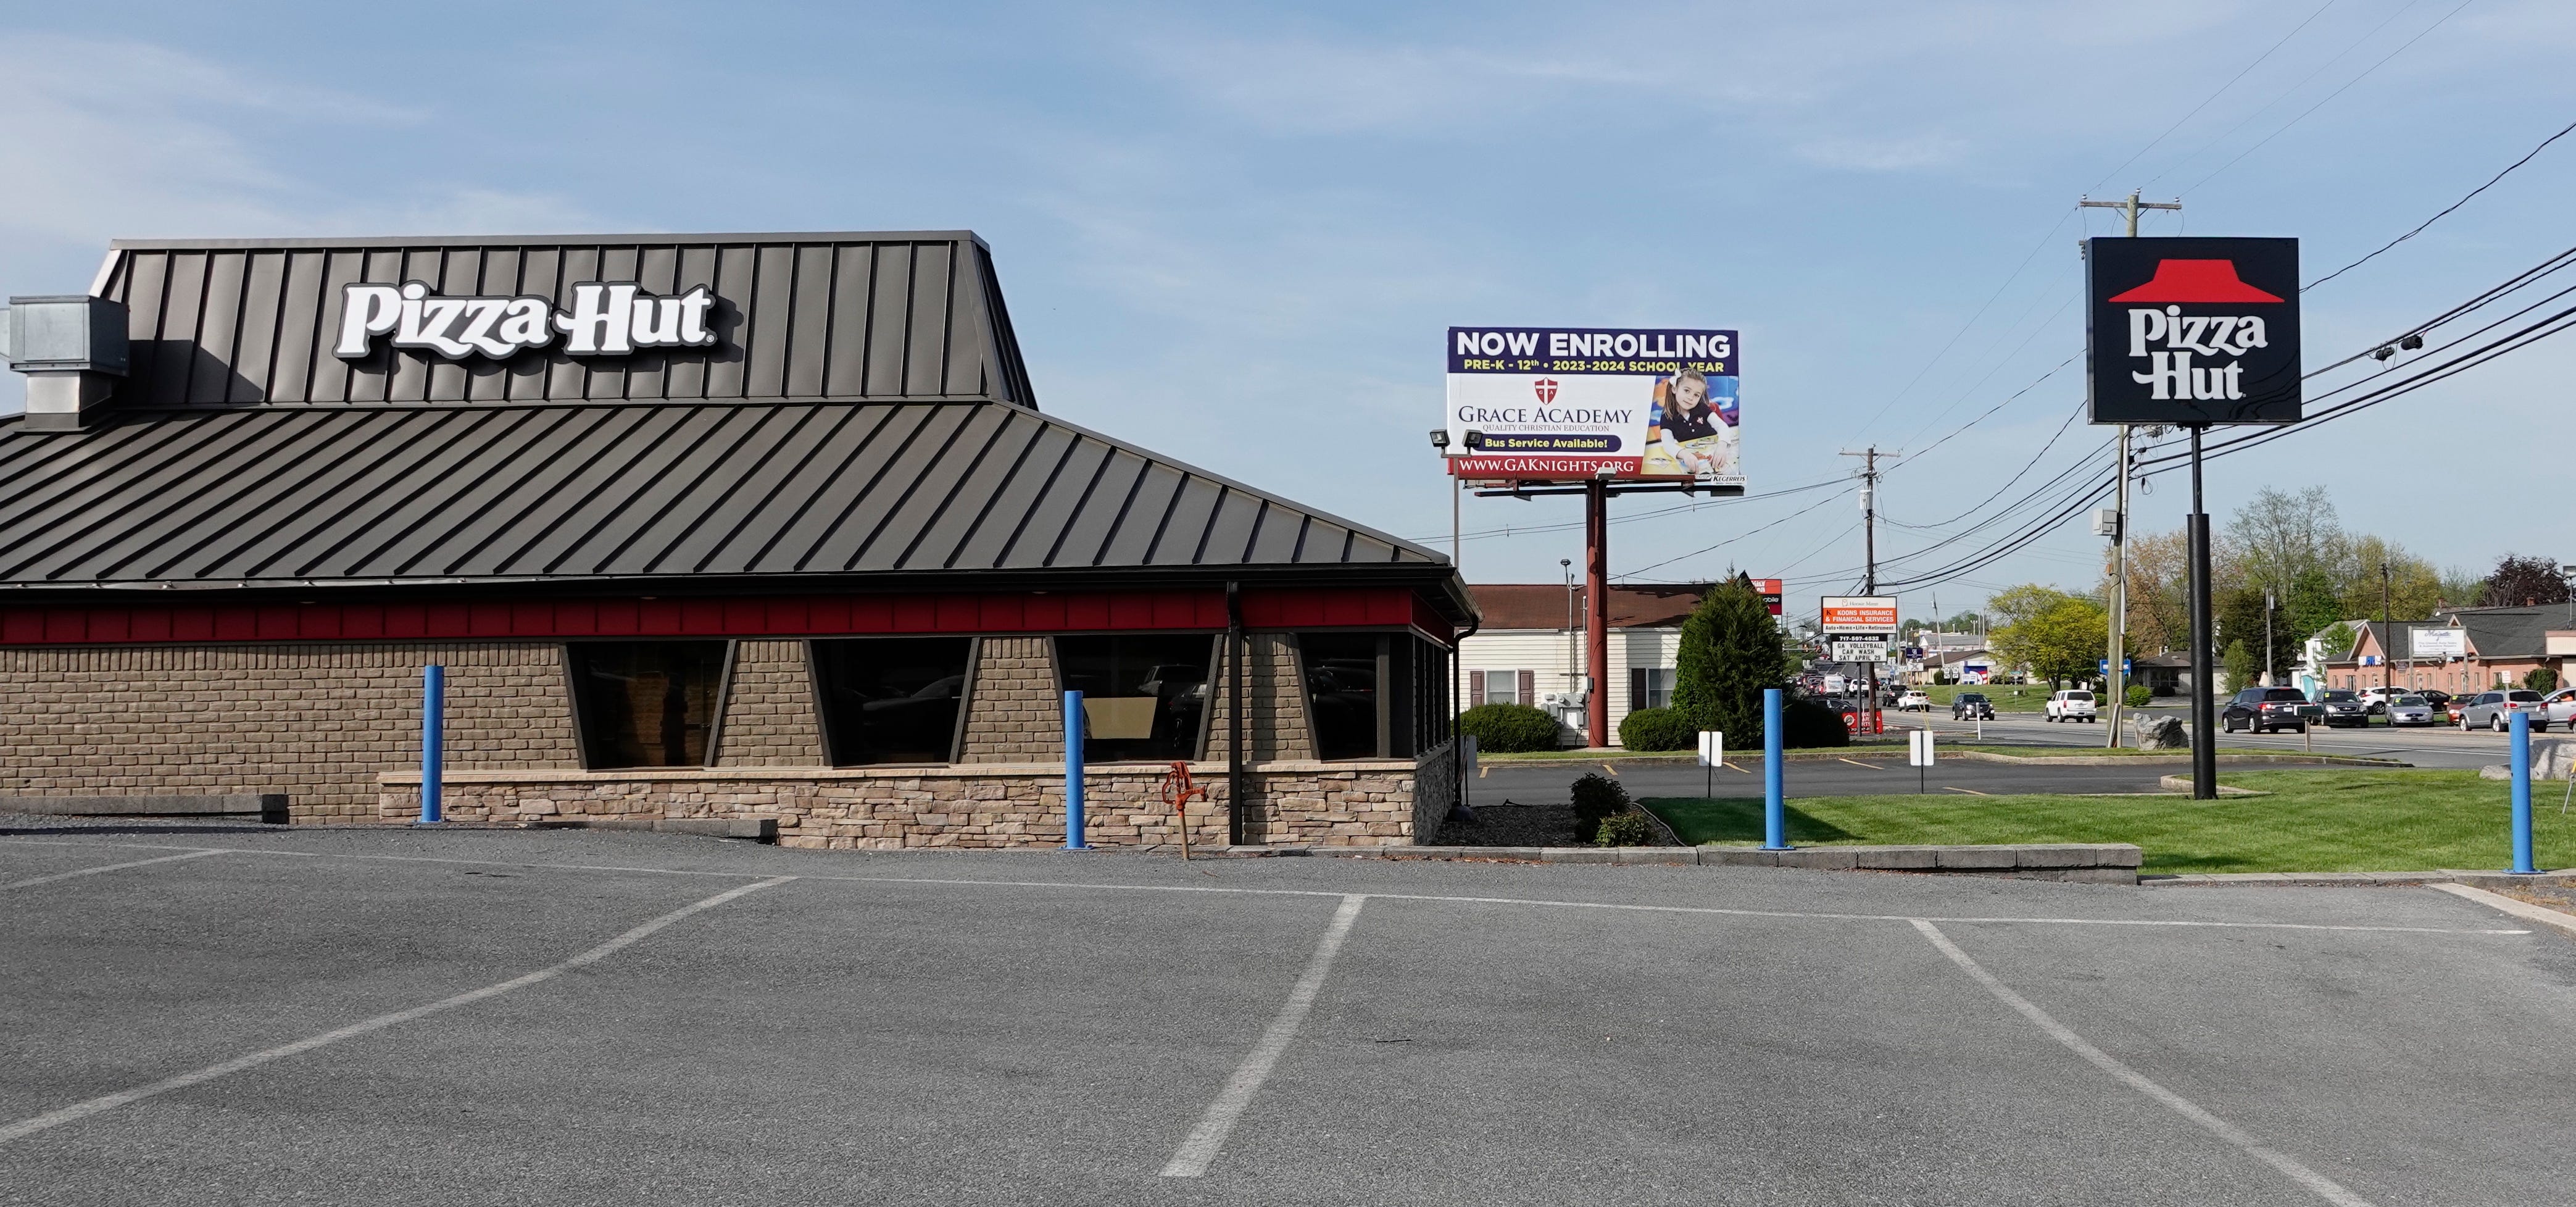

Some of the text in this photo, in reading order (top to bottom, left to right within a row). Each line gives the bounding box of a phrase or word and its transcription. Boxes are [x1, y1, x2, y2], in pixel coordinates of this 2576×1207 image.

[337, 283, 712, 356] Pizza Hut
[2128, 304, 2268, 356] Pizza
[1457, 332, 1730, 358] NOW ENROLLING
[1464, 359, 1505, 370] PRE-K
[1517, 359, 1539, 370] 12th
[1553, 360, 1626, 371] 2023-2024
[2132, 351, 2244, 400] Hut
[1458, 406, 1634, 424] GRACE ACADEMY
[1485, 438, 1608, 448] Bus Service Available!
